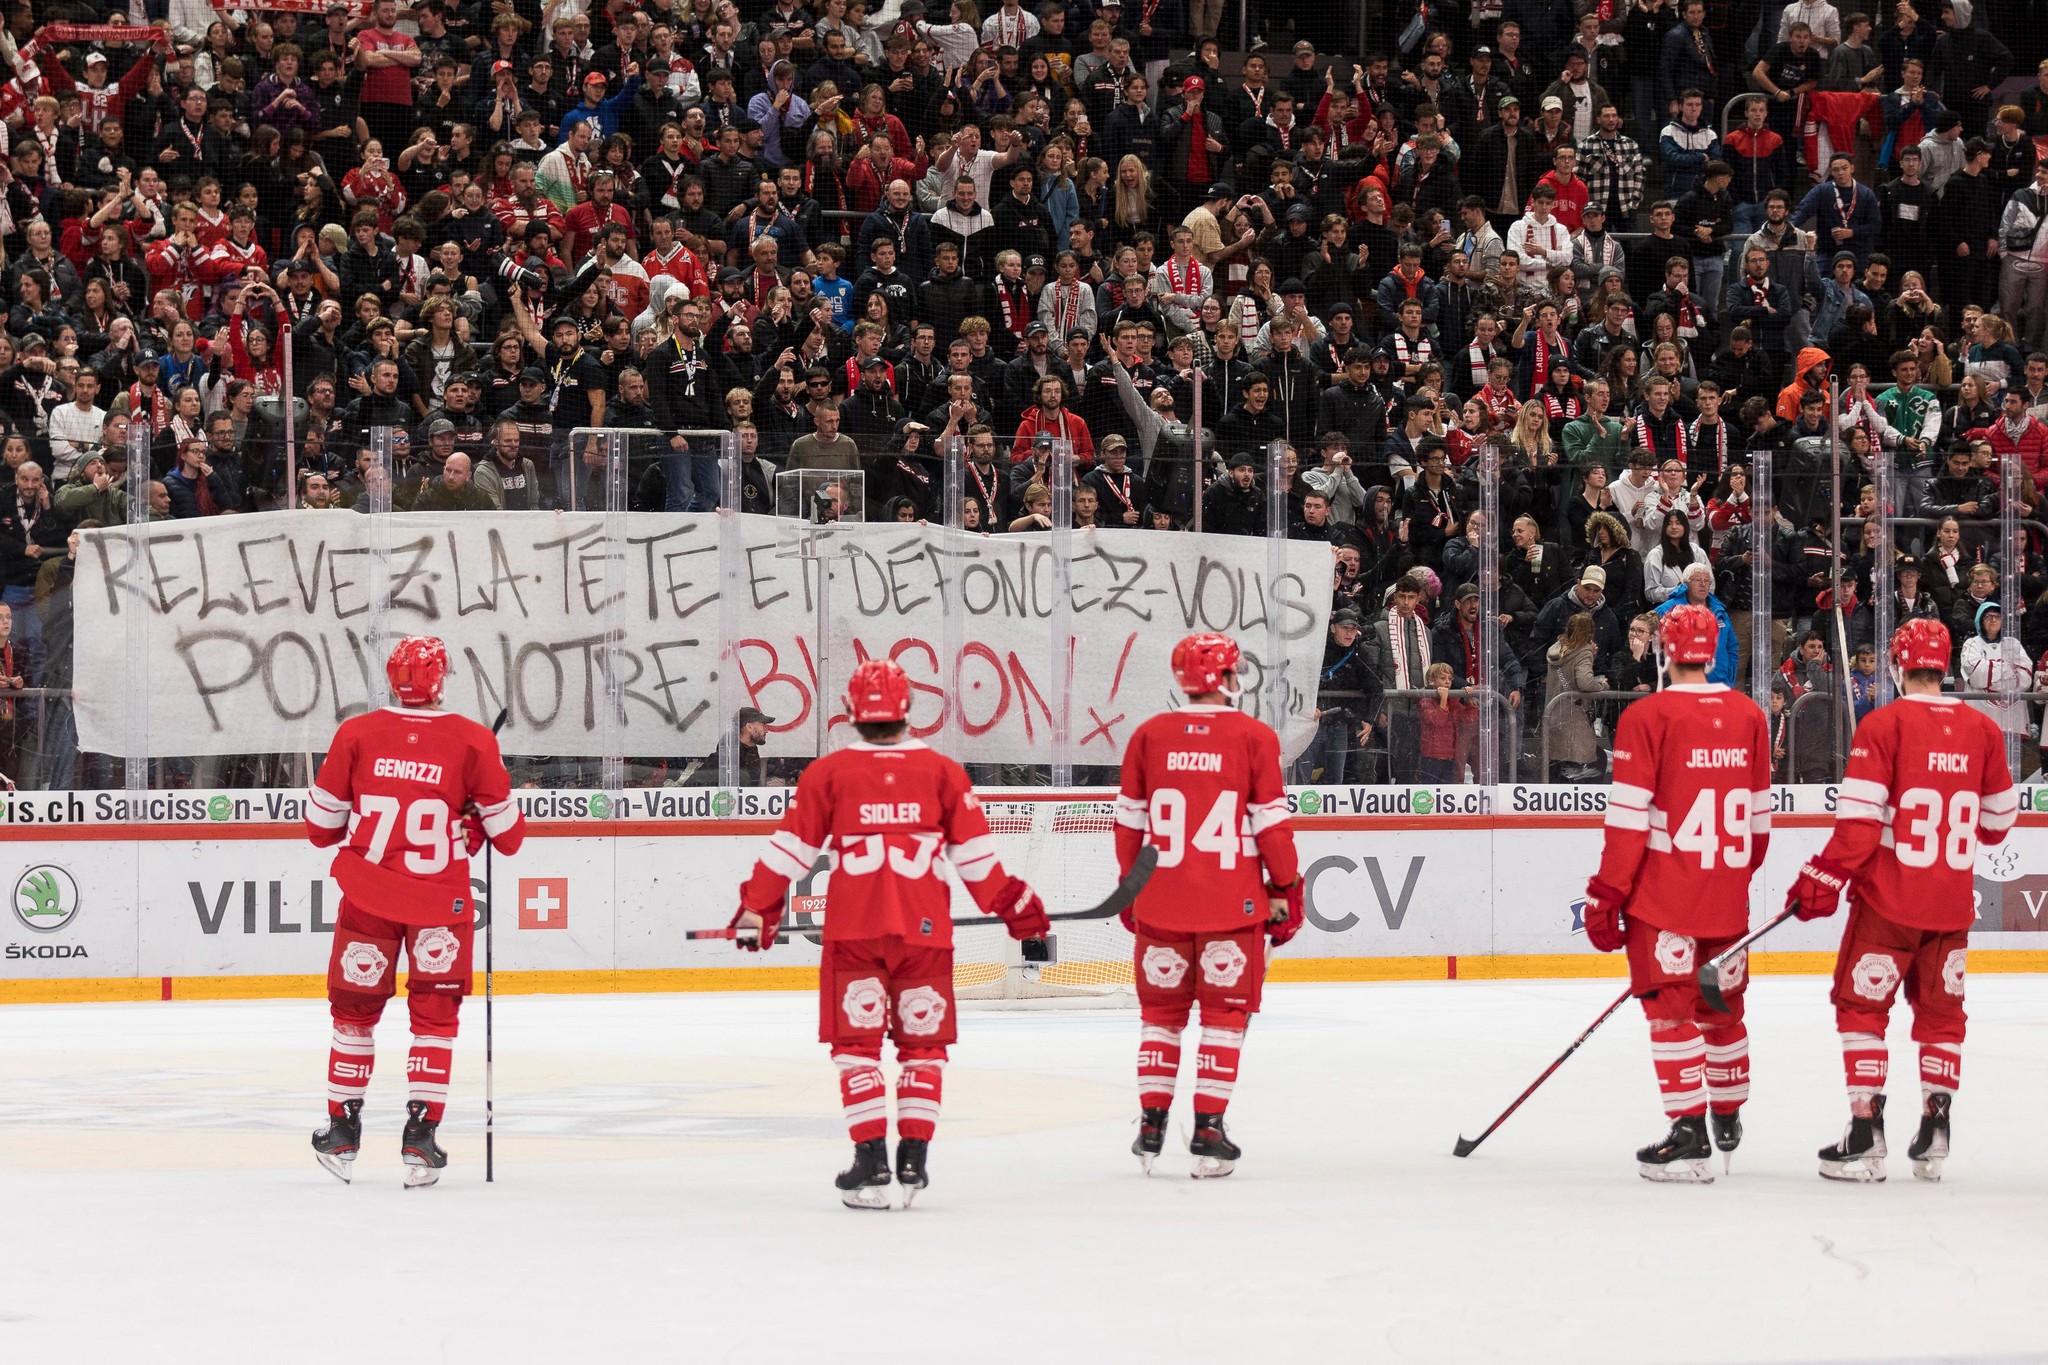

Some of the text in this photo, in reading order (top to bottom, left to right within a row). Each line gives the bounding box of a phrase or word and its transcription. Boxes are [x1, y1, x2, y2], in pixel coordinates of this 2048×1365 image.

[175, 625, 394, 732] POU
[373, 757, 443, 785] GENAZZI
[1166, 751, 1223, 773] BOZON
[1686, 747, 1748, 769] JELOVAC
[1927, 751, 1970, 774] FRICK
[859, 802, 921, 825] SIDLER
[360, 794, 450, 875] 79
[1150, 788, 1240, 870] 94
[1672, 787, 1753, 870] 49
[1895, 787, 1981, 871] 38
[5, 943, 89, 959] ŠKODA
